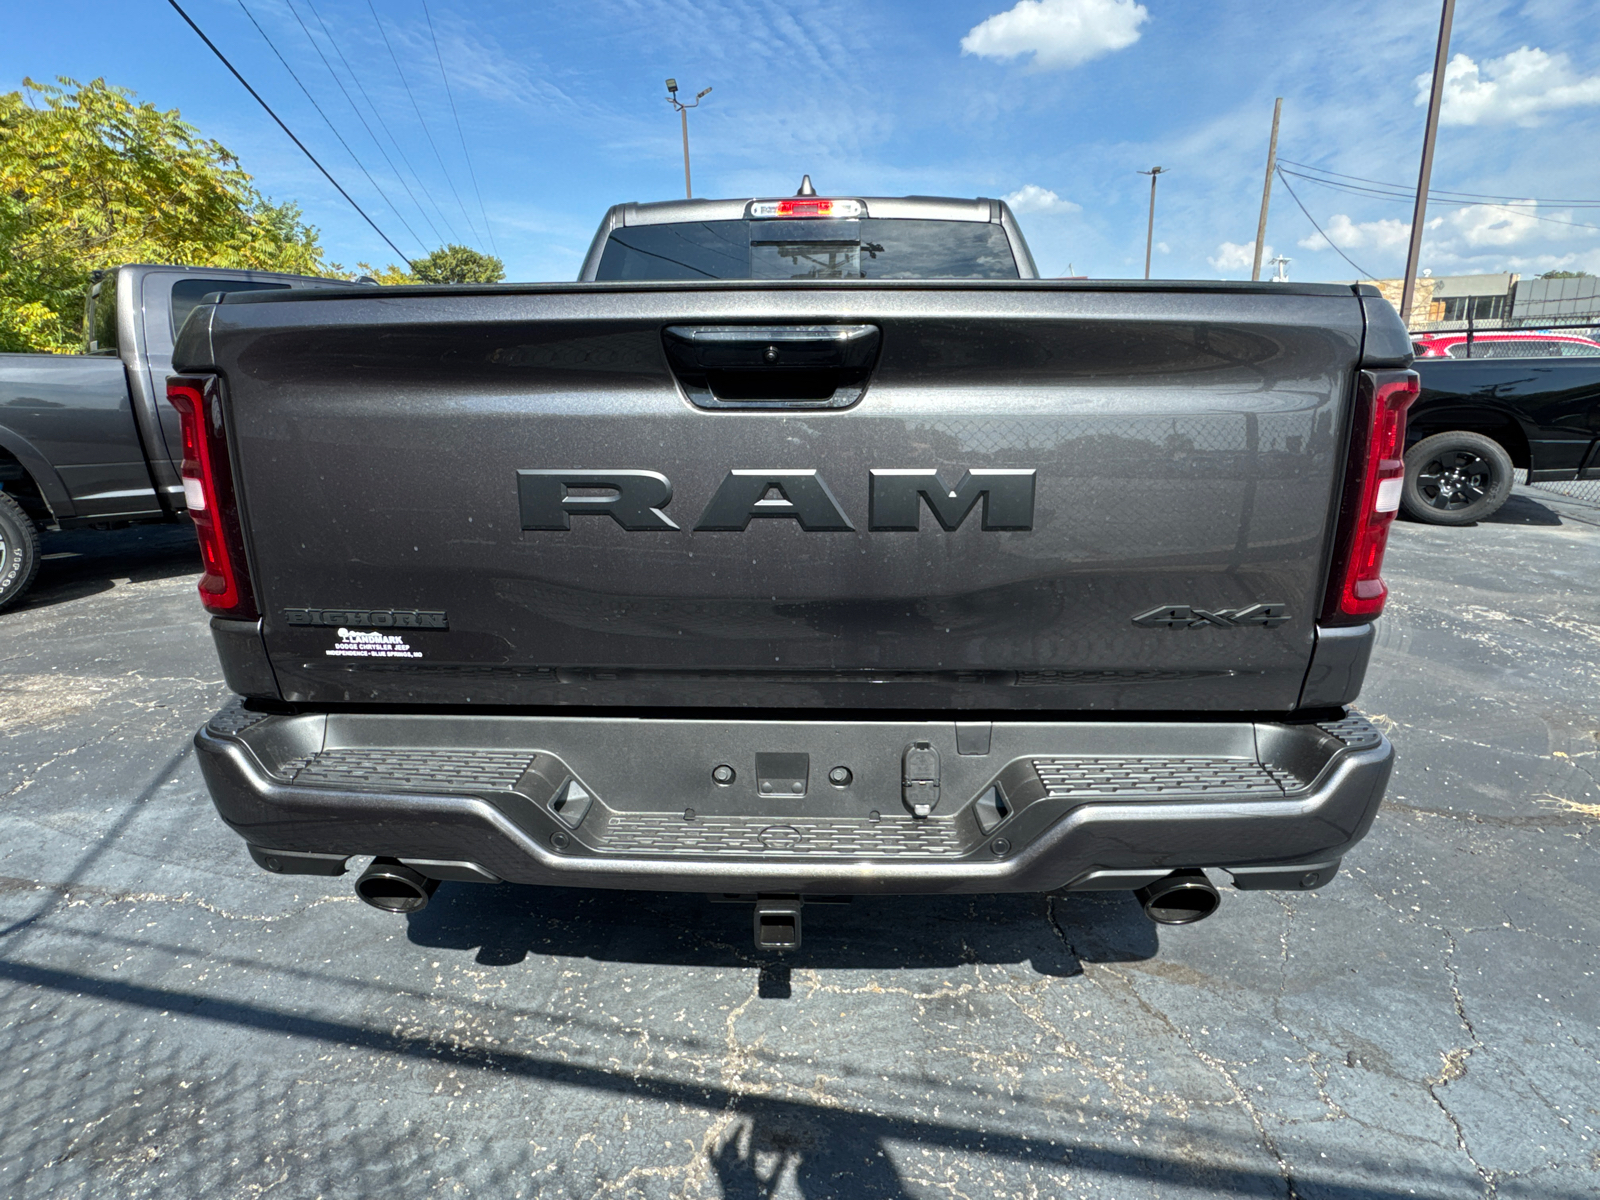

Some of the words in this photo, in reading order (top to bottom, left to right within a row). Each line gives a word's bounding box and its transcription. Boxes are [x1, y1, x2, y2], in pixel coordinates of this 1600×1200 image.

[516, 469, 1037, 532] RAM
[284, 608, 448, 629] BIGHORN
[349, 635, 403, 644] LANDMARK
